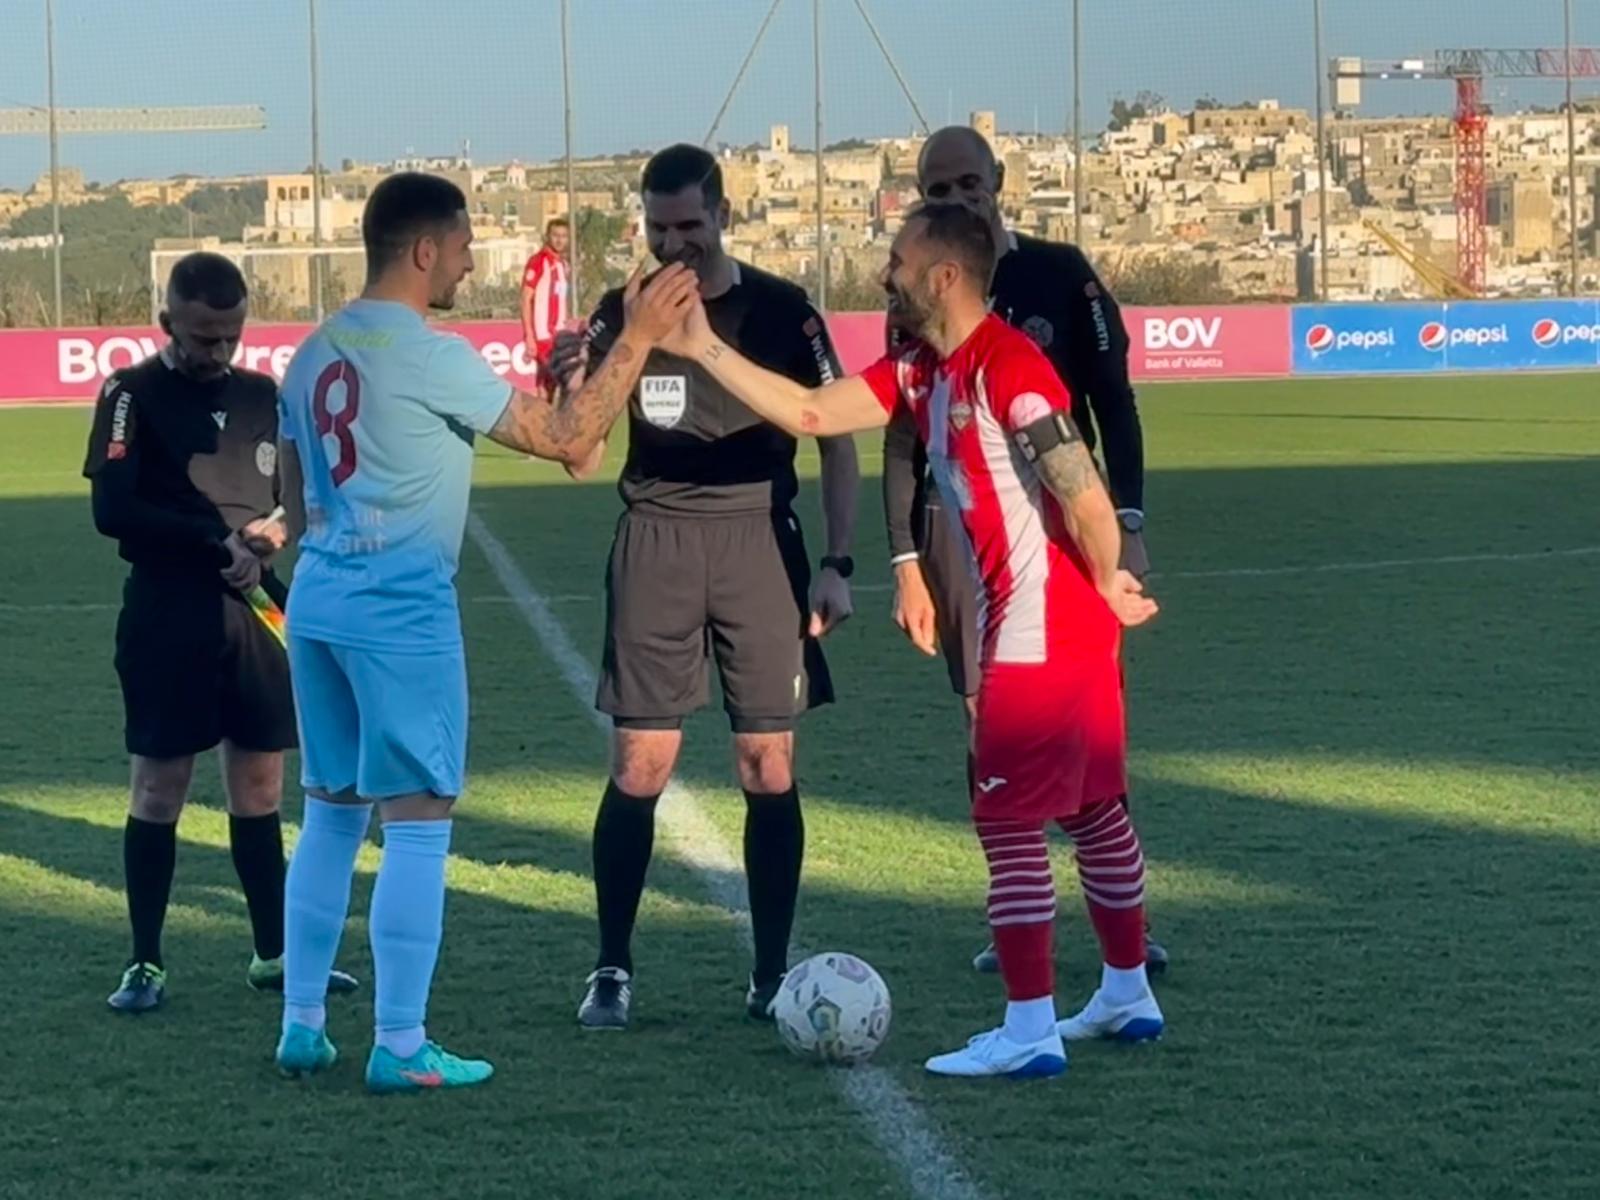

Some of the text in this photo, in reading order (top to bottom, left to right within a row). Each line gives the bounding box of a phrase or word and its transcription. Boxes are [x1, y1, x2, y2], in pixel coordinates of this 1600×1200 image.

[1144, 316, 1222, 349] BOV
[1336, 327, 1396, 349] pepsi
[1450, 324, 1509, 347] pepsi
[58, 336, 158, 383] BO
[1145, 356, 1223, 369] Bank of Valletta
[645, 379, 681, 392] FIFA
[314, 361, 360, 488] 8
